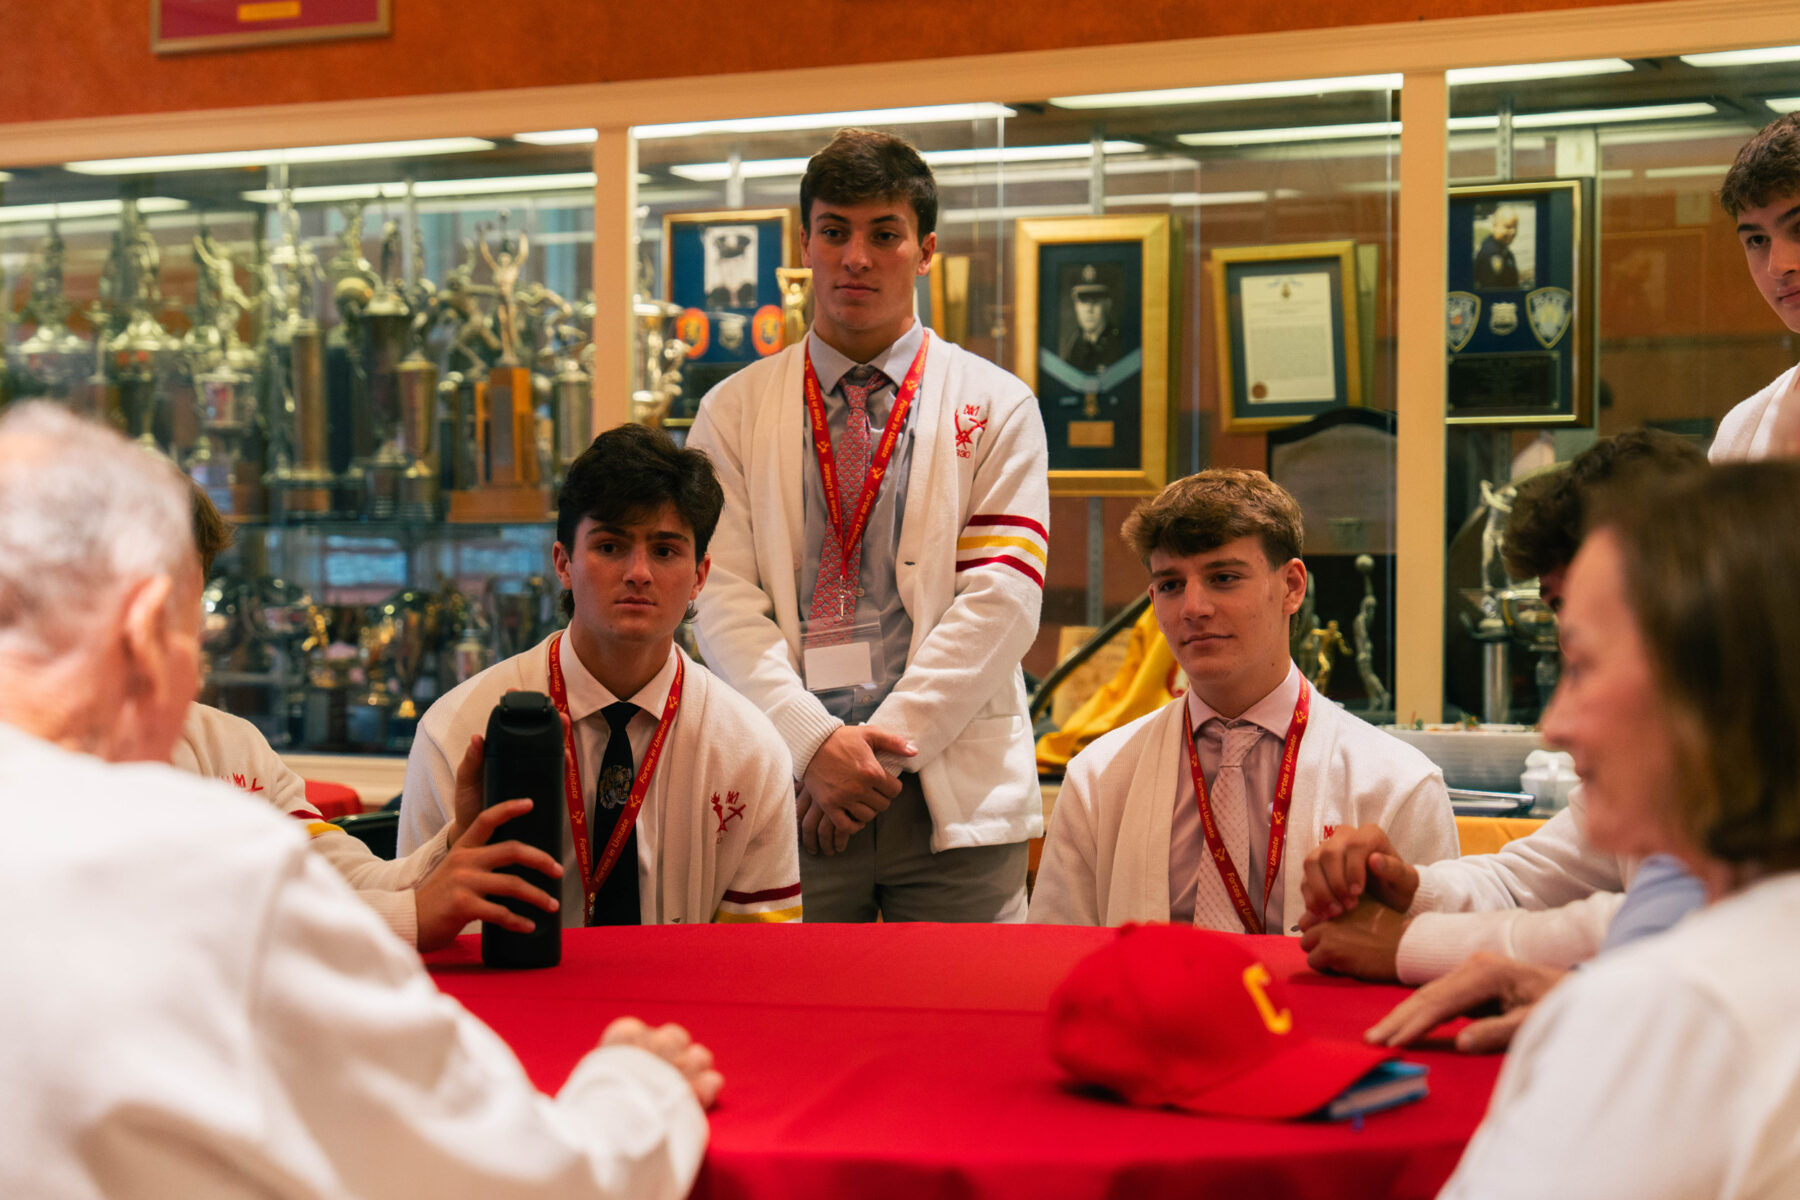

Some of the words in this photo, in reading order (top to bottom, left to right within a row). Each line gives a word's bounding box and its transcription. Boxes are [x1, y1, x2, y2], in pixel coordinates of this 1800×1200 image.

[807, 378, 817, 400] Unitate
[811, 400, 818, 408] in
[895, 399, 908, 422] Fortes
[815, 408, 823, 430] Fortes
[891, 423, 899, 431] in
[881, 431, 897, 459] Unitate
[824, 463, 834, 490] Unitate
[861, 489, 875, 515] Fortes
[858, 515, 864, 523] in
[551, 654, 557, 662] in
[552, 663, 561, 692] Unitate
[653, 719, 668, 747] Unitate
[650, 748, 657, 757] in
[1285, 734, 1297, 763] Unitate
[639, 757, 654, 784] Fortes
[1283, 763, 1291, 773] in
[569, 768, 579, 800] Unitate
[1197, 777, 1206, 802] Fortes
[1278, 773, 1290, 800] Fortes
[1201, 803, 1207, 811] in
[611, 818, 630, 848] Unitate
[1203, 811, 1216, 840] Unitate
[580, 838, 589, 866] Fortes
[607, 848, 616, 858] in
[1270, 836, 1280, 867] Unitate
[583, 866, 590, 875] in
[595, 857, 611, 882] Fortes
[1226, 872, 1243, 898] Fortes
[1239, 899, 1247, 907] in
